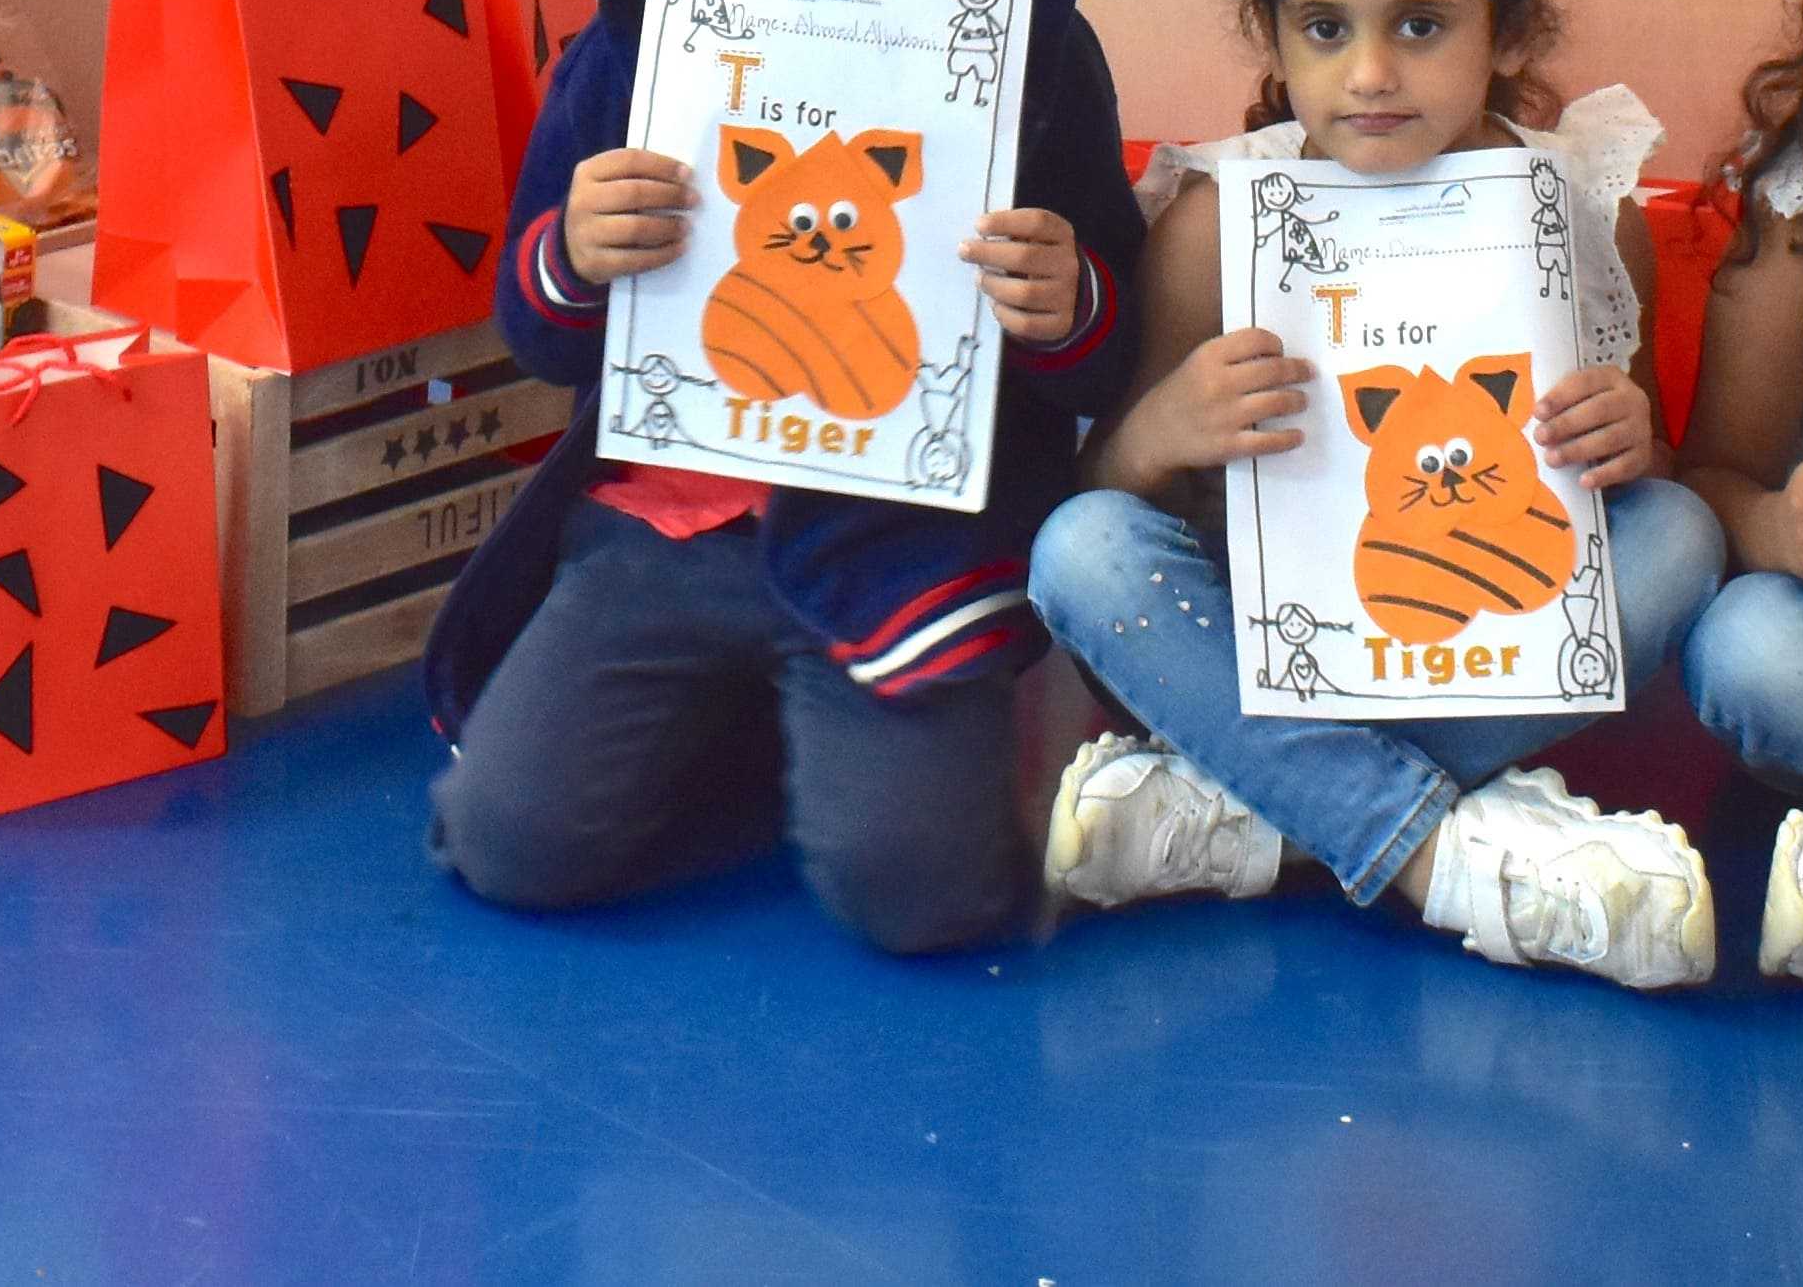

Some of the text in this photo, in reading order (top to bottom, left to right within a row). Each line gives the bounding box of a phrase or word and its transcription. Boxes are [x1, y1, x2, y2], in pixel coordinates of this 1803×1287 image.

[715, 50, 837, 128] T is for
[1311, 282, 1438, 349] T is for
[723, 396, 877, 457] Tiger
[1363, 637, 1520, 685] Tiger
